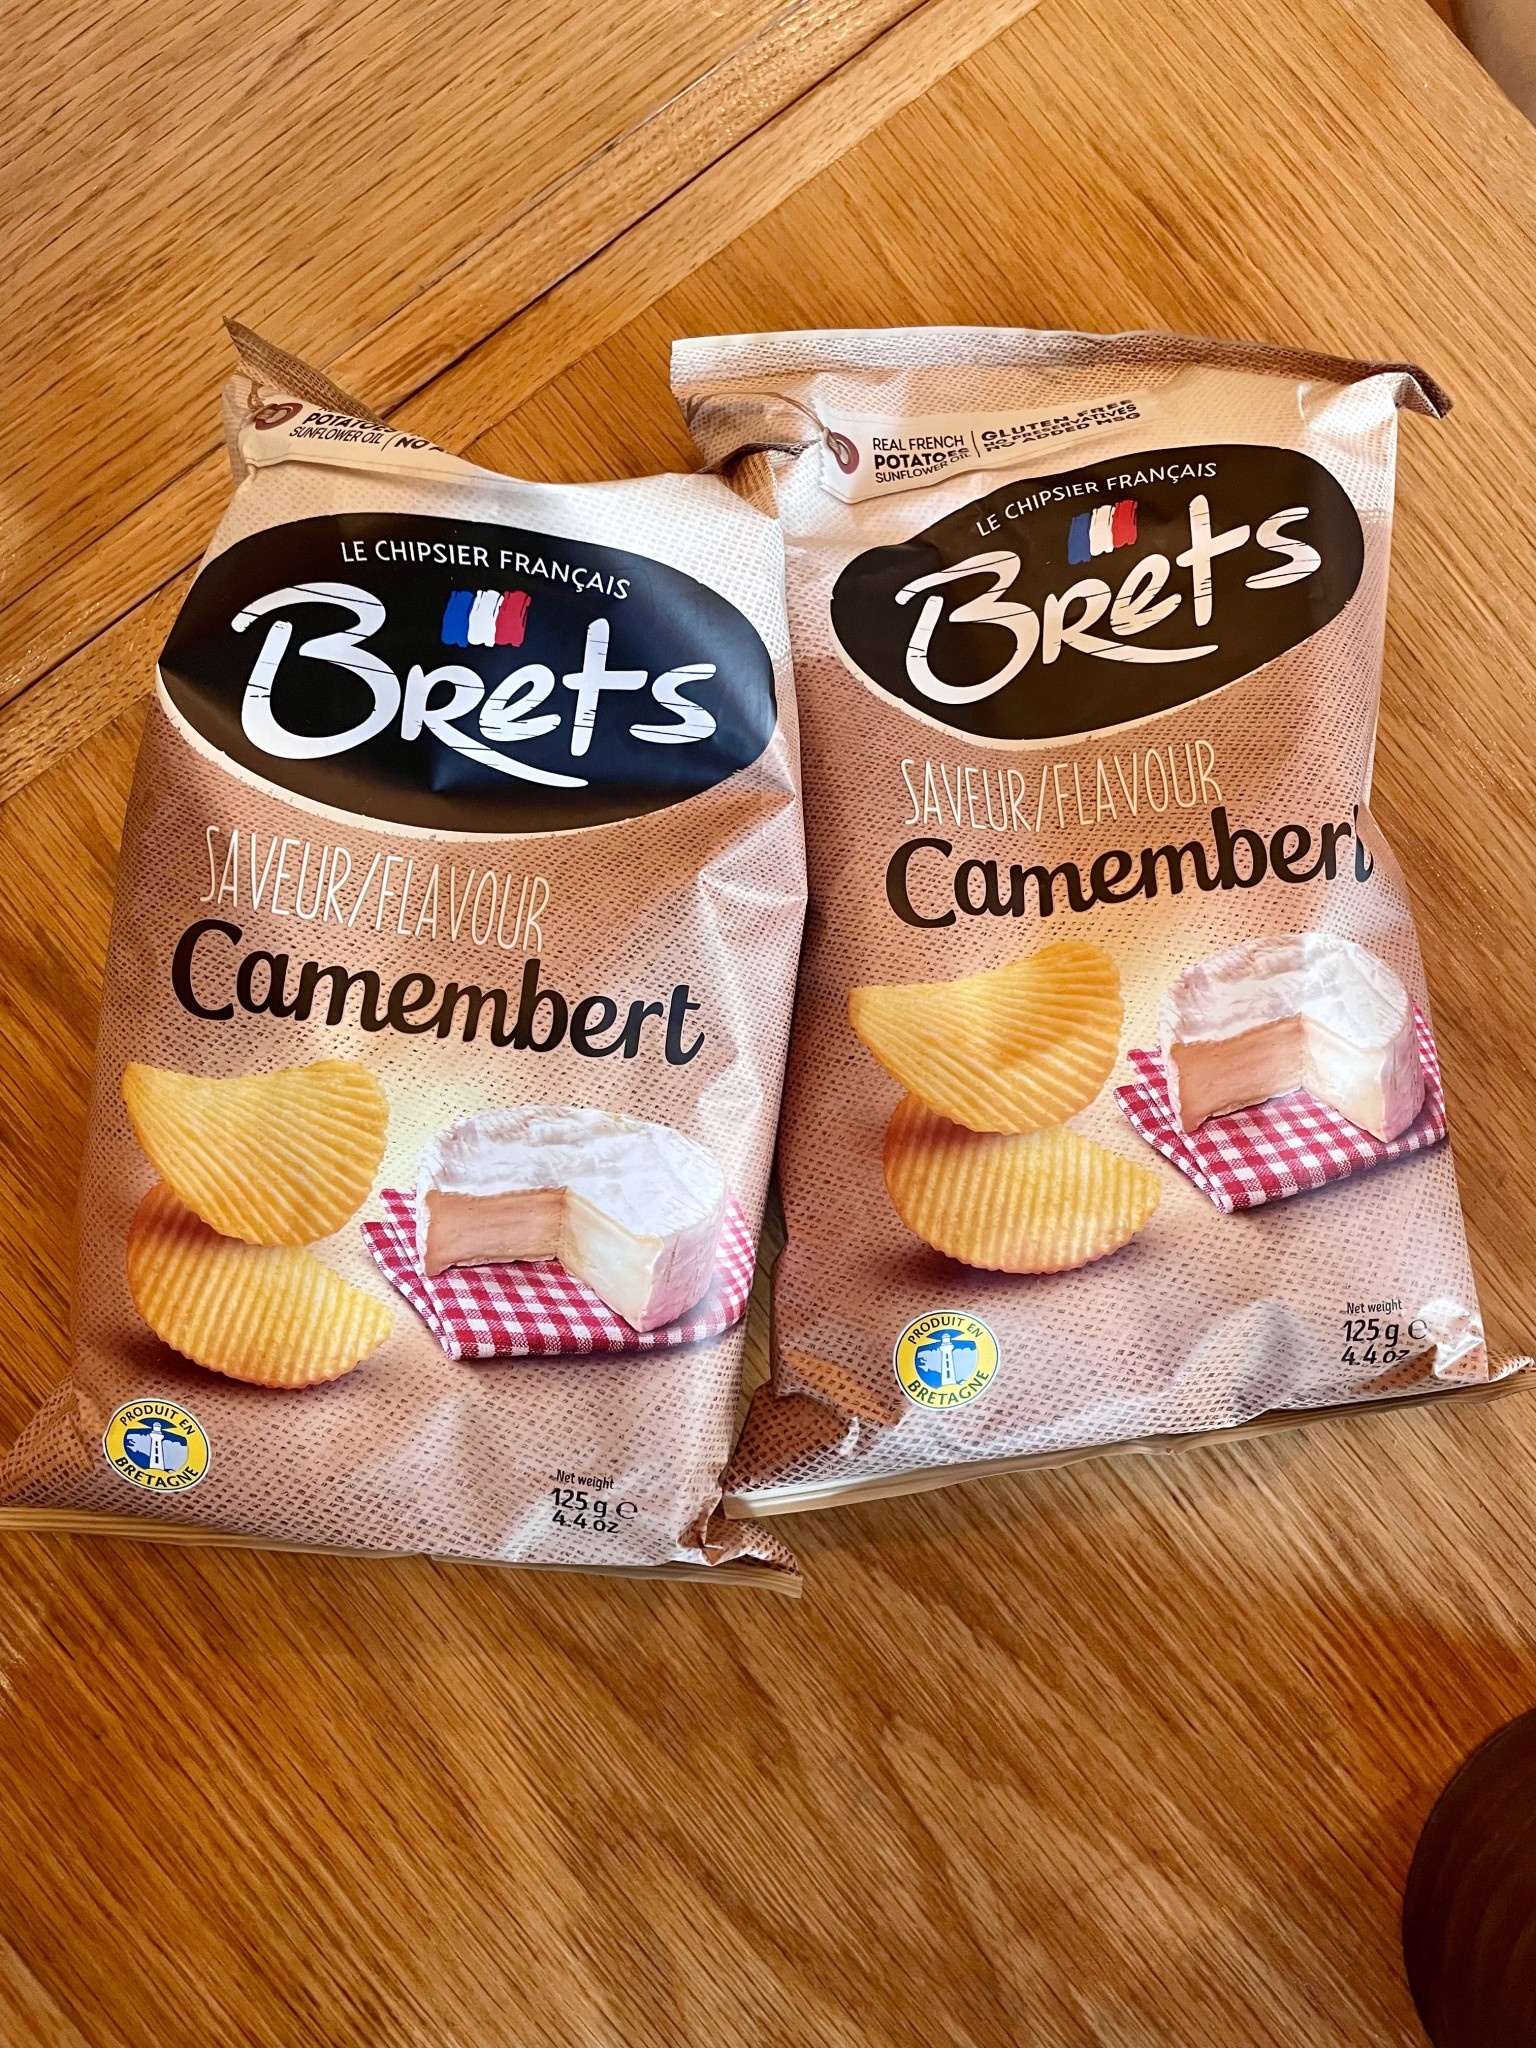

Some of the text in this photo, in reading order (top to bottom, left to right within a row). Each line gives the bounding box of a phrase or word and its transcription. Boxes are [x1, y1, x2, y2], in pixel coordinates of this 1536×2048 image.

[289, 426, 385, 445] SUNFLOWER OIL
[981, 399, 1133, 441] GLUTEN FREE
[986, 412, 1141, 452] NO ADDED MSG
[1012, 404, 1137, 441] PRESERVATIVES
[394, 436, 430, 450] NO
[873, 435, 964, 451] REAL FRENCH
[874, 447, 970, 470] POTATOES
[875, 453, 972, 483] SUNFLOWER OIL
[976, 462, 1217, 537] LE CHIPSIER FRANÇAIS
[340, 540, 632, 600] LE CHIPSIER FRANÇAIS
[900, 739, 1223, 834] SAVEUR/FLAVOUR
[200, 825, 550, 953] SAVEUR/FLAVOUR
[171, 918, 705, 1067] Camembert
[1346, 1299, 1403, 1315] Net weight
[907, 1316, 984, 1345] PRODUIT EN
[1342, 1318, 1380, 1342] 125
[1385, 1323, 1399, 1348] g
[1341, 1344, 1410, 1366] 4.4 oz
[907, 1370, 990, 1405] BRETAGNE
[119, 1404, 196, 1436] PRODUIT EN
[114, 1456, 199, 1488] BRETAGNE
[556, 1469, 615, 1492] Net weight
[550, 1487, 588, 1511] 125
[593, 1500, 608, 1519] g
[552, 1509, 620, 1534] 4.4 oz
